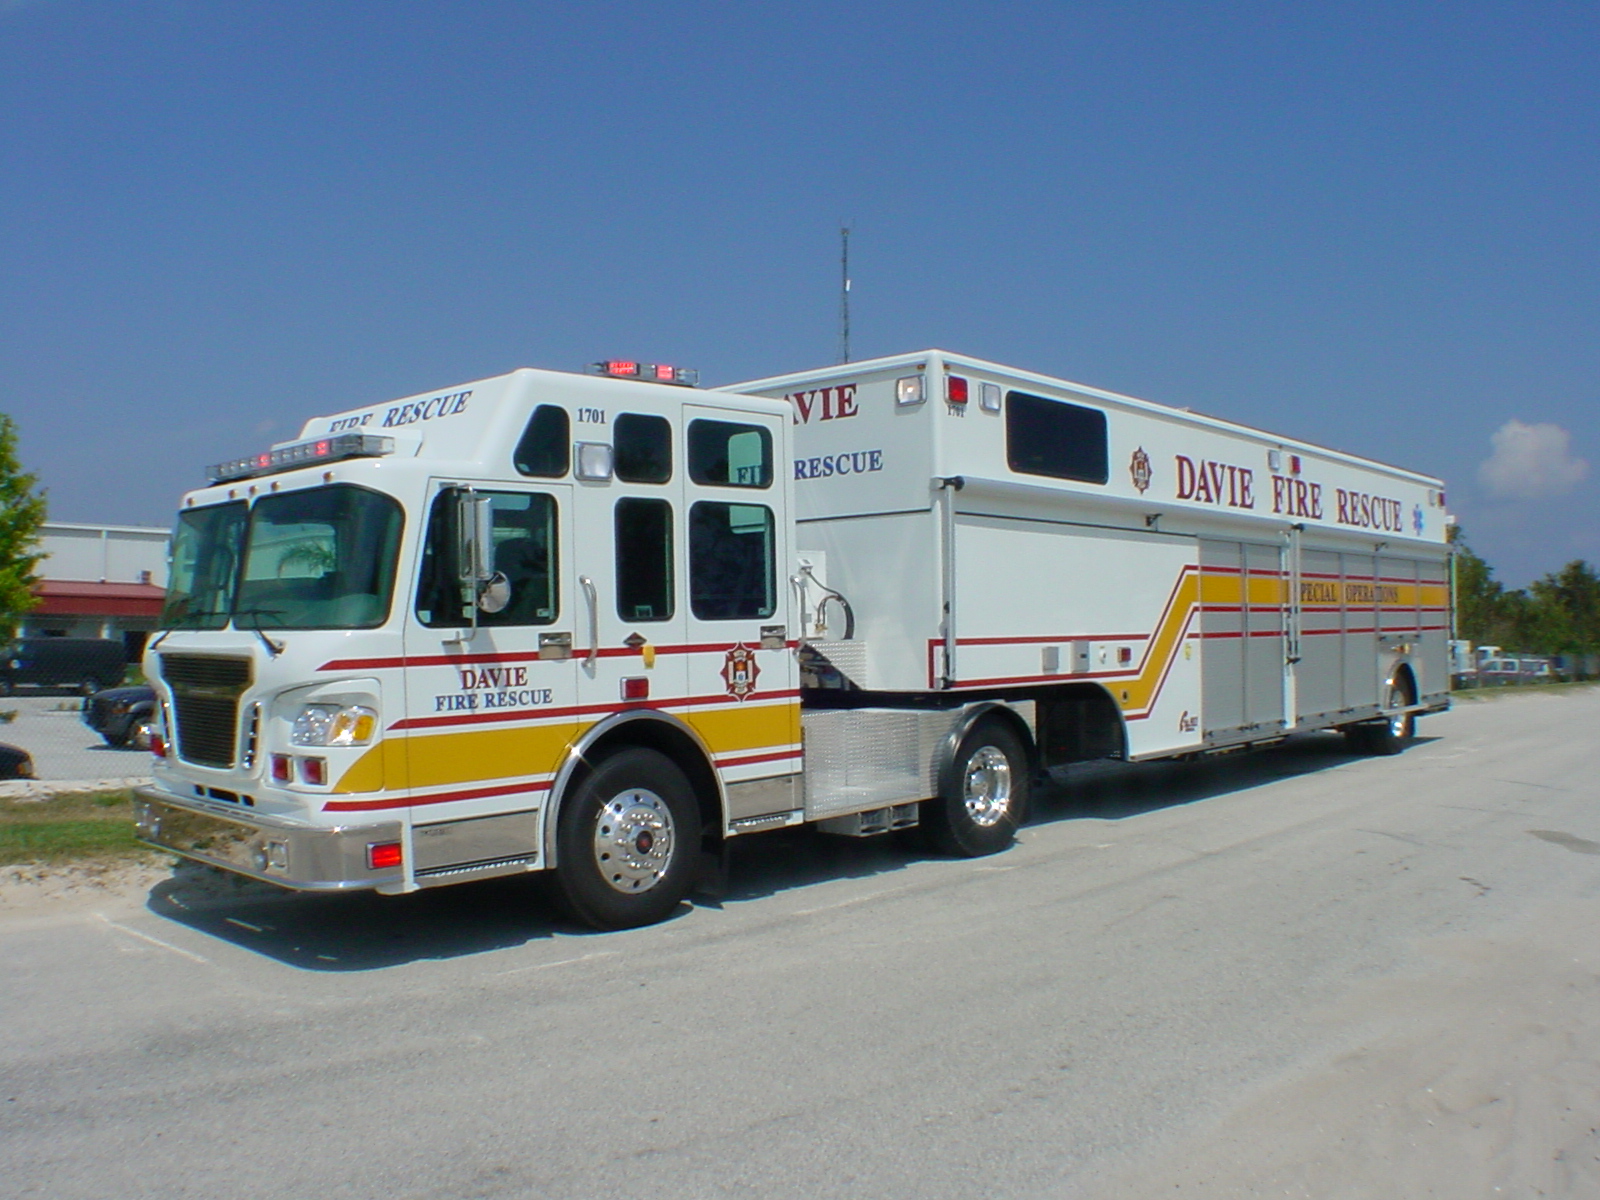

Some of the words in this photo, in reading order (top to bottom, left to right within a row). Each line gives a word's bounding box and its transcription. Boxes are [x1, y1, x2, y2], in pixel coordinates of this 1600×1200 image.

[382, 390, 473, 428] RESCUE
[577, 407, 606, 424] 1701
[784, 383, 859, 425] VIE
[794, 449, 883, 480] RESCUE
[1175, 454, 1254, 510] DAVIE
[1271, 474, 1323, 520] FIRE
[1336, 488, 1402, 532] RESCUE
[1300, 583, 1337, 602] PECIAL
[461, 666, 528, 690] DAVIE
[435, 694, 479, 711] FIRE
[485, 689, 553, 708] RESCUE
